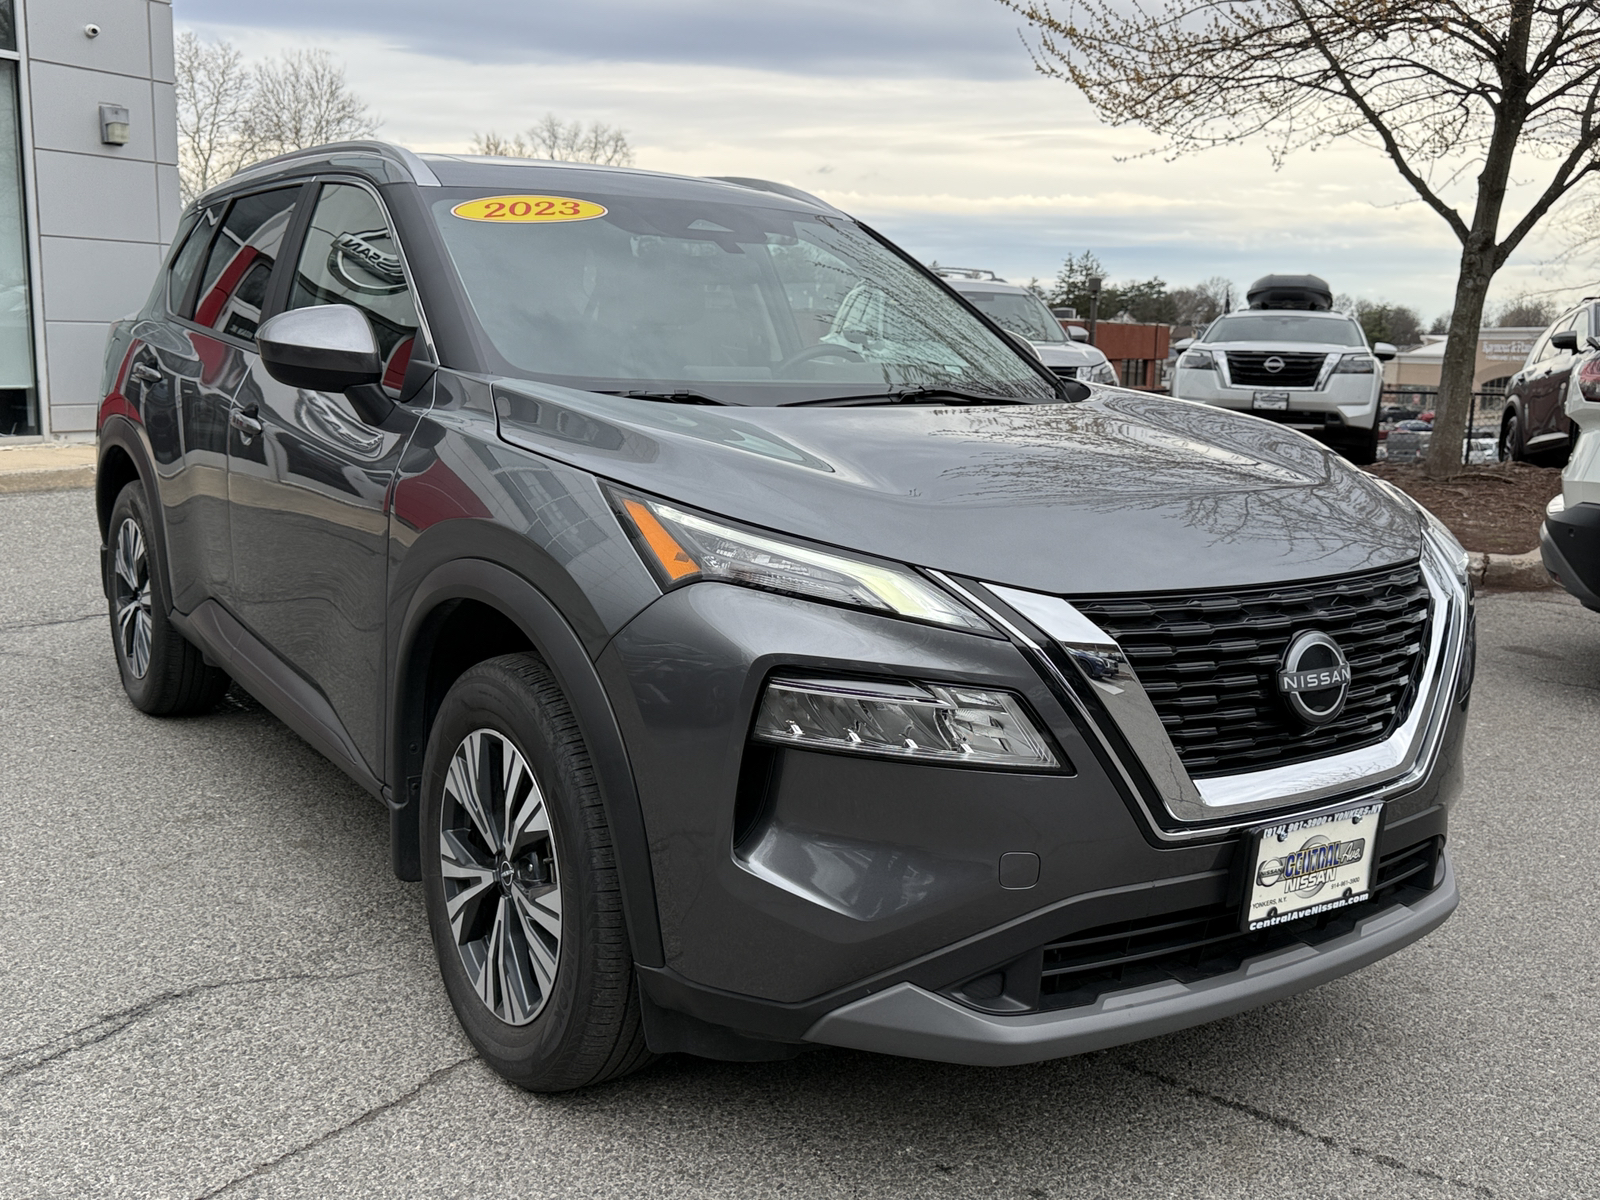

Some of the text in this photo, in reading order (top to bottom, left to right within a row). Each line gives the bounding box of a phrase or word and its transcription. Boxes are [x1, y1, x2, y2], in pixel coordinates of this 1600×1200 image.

[484, 201, 581, 218] 2023
[1283, 667, 1350, 690] NISSAN
[1260, 868, 1283, 876] NISSAN
[1285, 841, 1340, 879] CENTRAL
[1284, 867, 1338, 894] NISSAN
